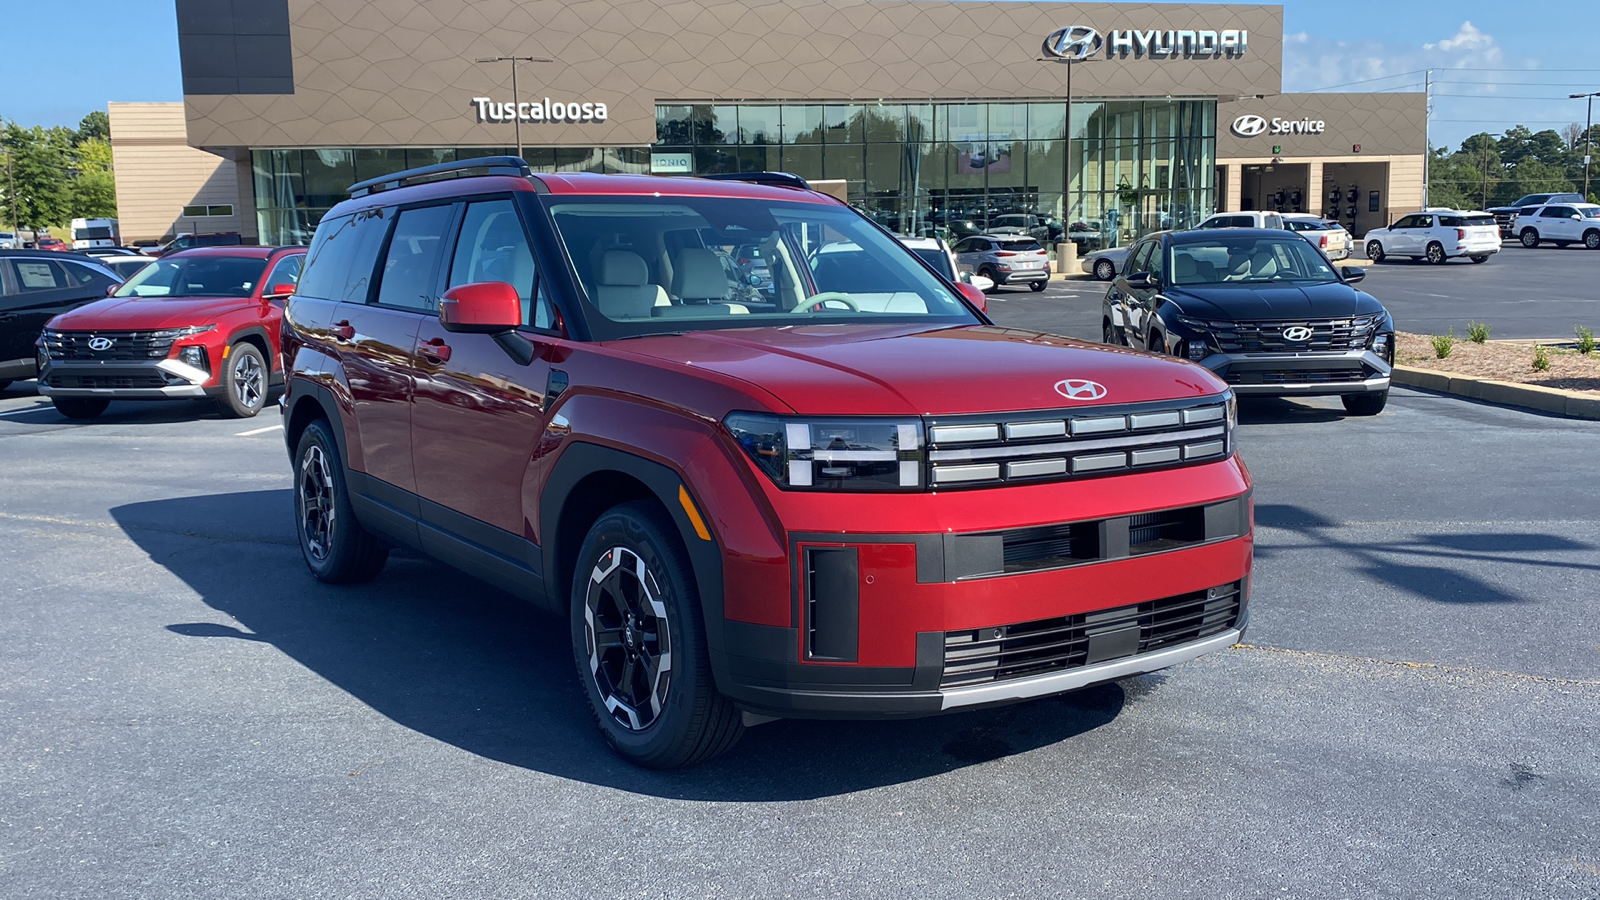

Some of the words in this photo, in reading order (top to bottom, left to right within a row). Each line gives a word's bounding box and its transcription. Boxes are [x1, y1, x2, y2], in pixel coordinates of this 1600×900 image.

[1112, 29, 1248, 54] HYUNDAI
[473, 97, 607, 120] Tuscaloosa
[1271, 116, 1326, 133] Service
[656, 158, 687, 167] IONIQ
